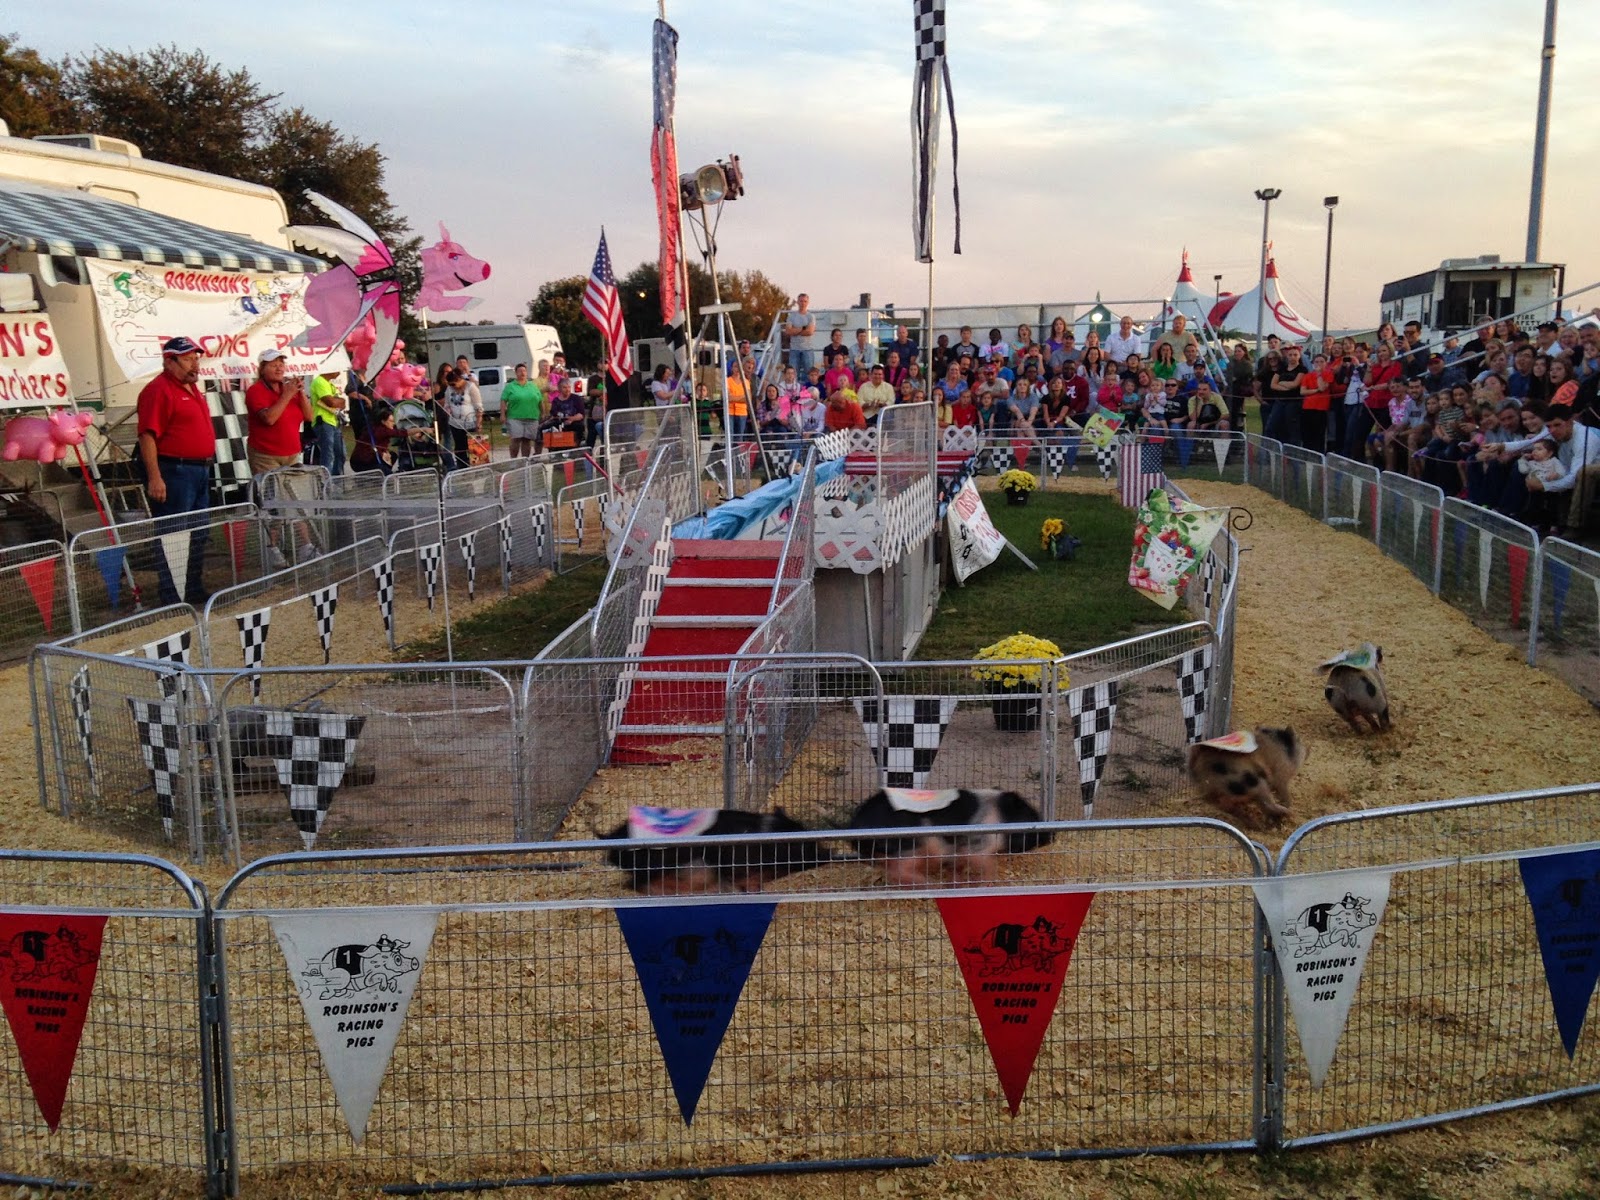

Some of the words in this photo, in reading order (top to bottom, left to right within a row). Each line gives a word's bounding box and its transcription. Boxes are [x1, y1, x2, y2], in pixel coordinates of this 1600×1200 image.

[164, 270, 250, 295] ROBINSON'S
[158, 333, 249, 358] CING
[1295, 956, 1357, 973] ROBINSON'S
[1306, 974, 1344, 988] RACING
[982, 982, 1053, 993] ROBINSON'S
[14, 987, 80, 1002] ROBINSON'S
[1313, 990, 1337, 1002] PIGS
[322, 1002, 399, 1016] ROBINSON'S
[993, 998, 1038, 1009] RACING
[27, 1005, 67, 1017] RACING
[1002, 1013, 1029, 1024] PIGS
[35, 1022, 61, 1034] PIGS
[337, 1019, 384, 1032] RACING
[346, 1036, 376, 1048] PIGS
